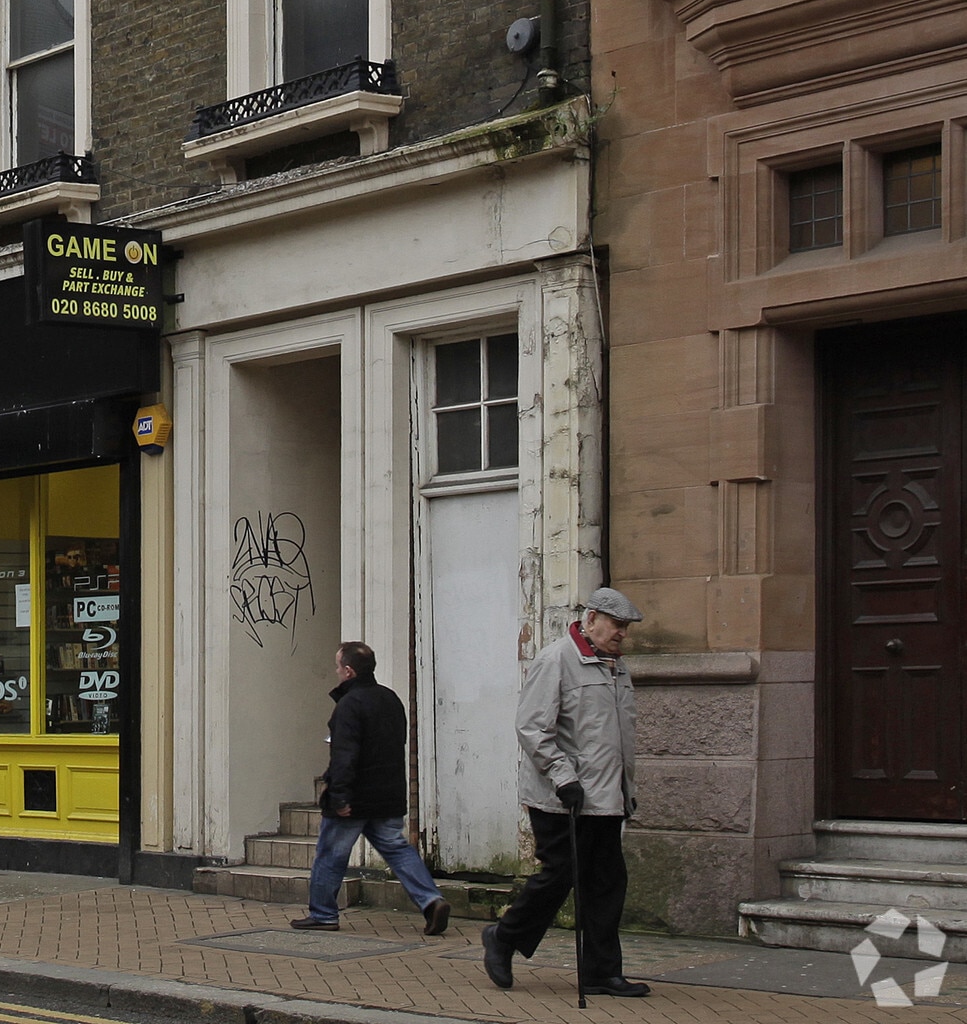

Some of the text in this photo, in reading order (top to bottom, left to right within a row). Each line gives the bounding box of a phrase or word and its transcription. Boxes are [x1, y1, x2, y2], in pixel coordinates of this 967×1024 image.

[47, 233, 158, 266] GAME ON
[69, 267, 94, 280] SELL
[102, 270, 125, 282] BUY
[126, 272, 134, 283] &
[62, 280, 145, 298] PART EXCHANGE
[51, 298, 157, 321] 020 8680 5008
[138, 420, 152, 432] ADT
[77, 601, 96, 618] PC
[79, 671, 119, 693] DVD
